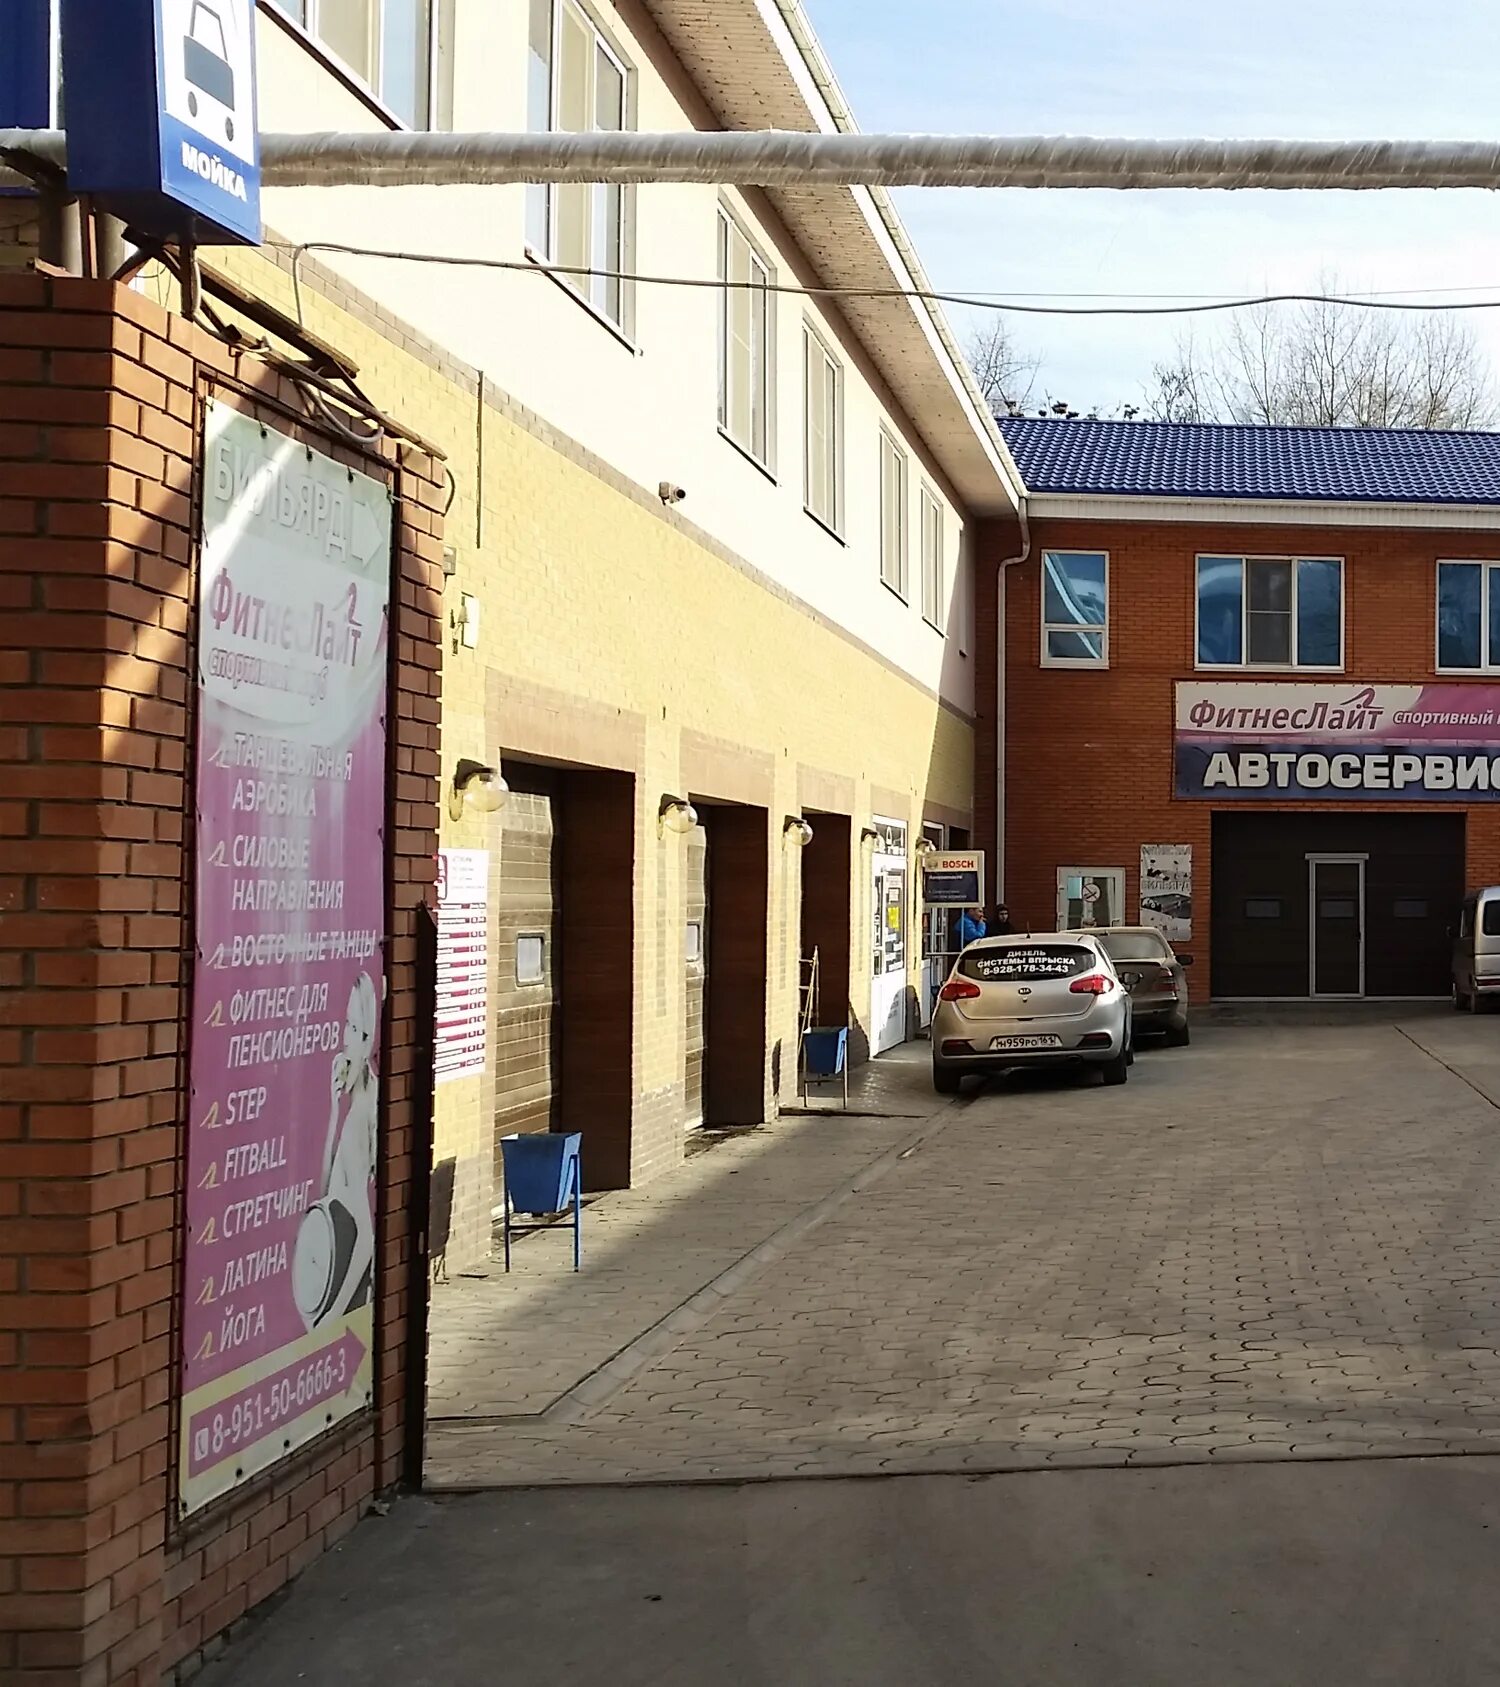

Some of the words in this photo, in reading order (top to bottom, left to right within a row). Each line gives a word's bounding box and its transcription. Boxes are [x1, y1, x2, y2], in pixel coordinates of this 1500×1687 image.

[182, 142, 247, 202] МОЙКА
[213, 437, 346, 563] БИЛЬЯРД
[1189, 700, 1383, 730] ФитнесЛайт
[1393, 708, 1494, 727] спортивный
[235, 732, 353, 780] ТАНЦЕВЛЬНАЯ
[232, 779, 317, 817] АЭРОБИКА
[232, 834, 310, 869] СИЛОВЫЕ
[942, 860, 974, 869] BOSCH
[232, 879, 344, 912] НАПРАВЛЕНИЯ
[330, 929, 377, 965] ТАНЦЫ
[977, 957, 1026, 969] СИСТЕМЫ
[1028, 956, 1076, 966] ВПРЫСКА
[1007, 949, 1047, 958] ДИЗЕЛЬ
[983, 964, 1069, 976] 8-928-178-34-43
[229, 985, 296, 1026] ФИТНЕС
[296, 983, 329, 1023] ДЛЯ
[227, 1021, 340, 1069] ПЕНСИОНЕРОВ
[225, 1086, 267, 1125] STEP
[223, 1136, 287, 1182] FITBALL
[223, 1180, 314, 1238] СТРЕТЧИНГ
[220, 1241, 287, 1296] ЛАТИНА
[220, 1304, 265, 1353] ЙОГА
[212, 1348, 346, 1454] 8-951-50-6666-3
